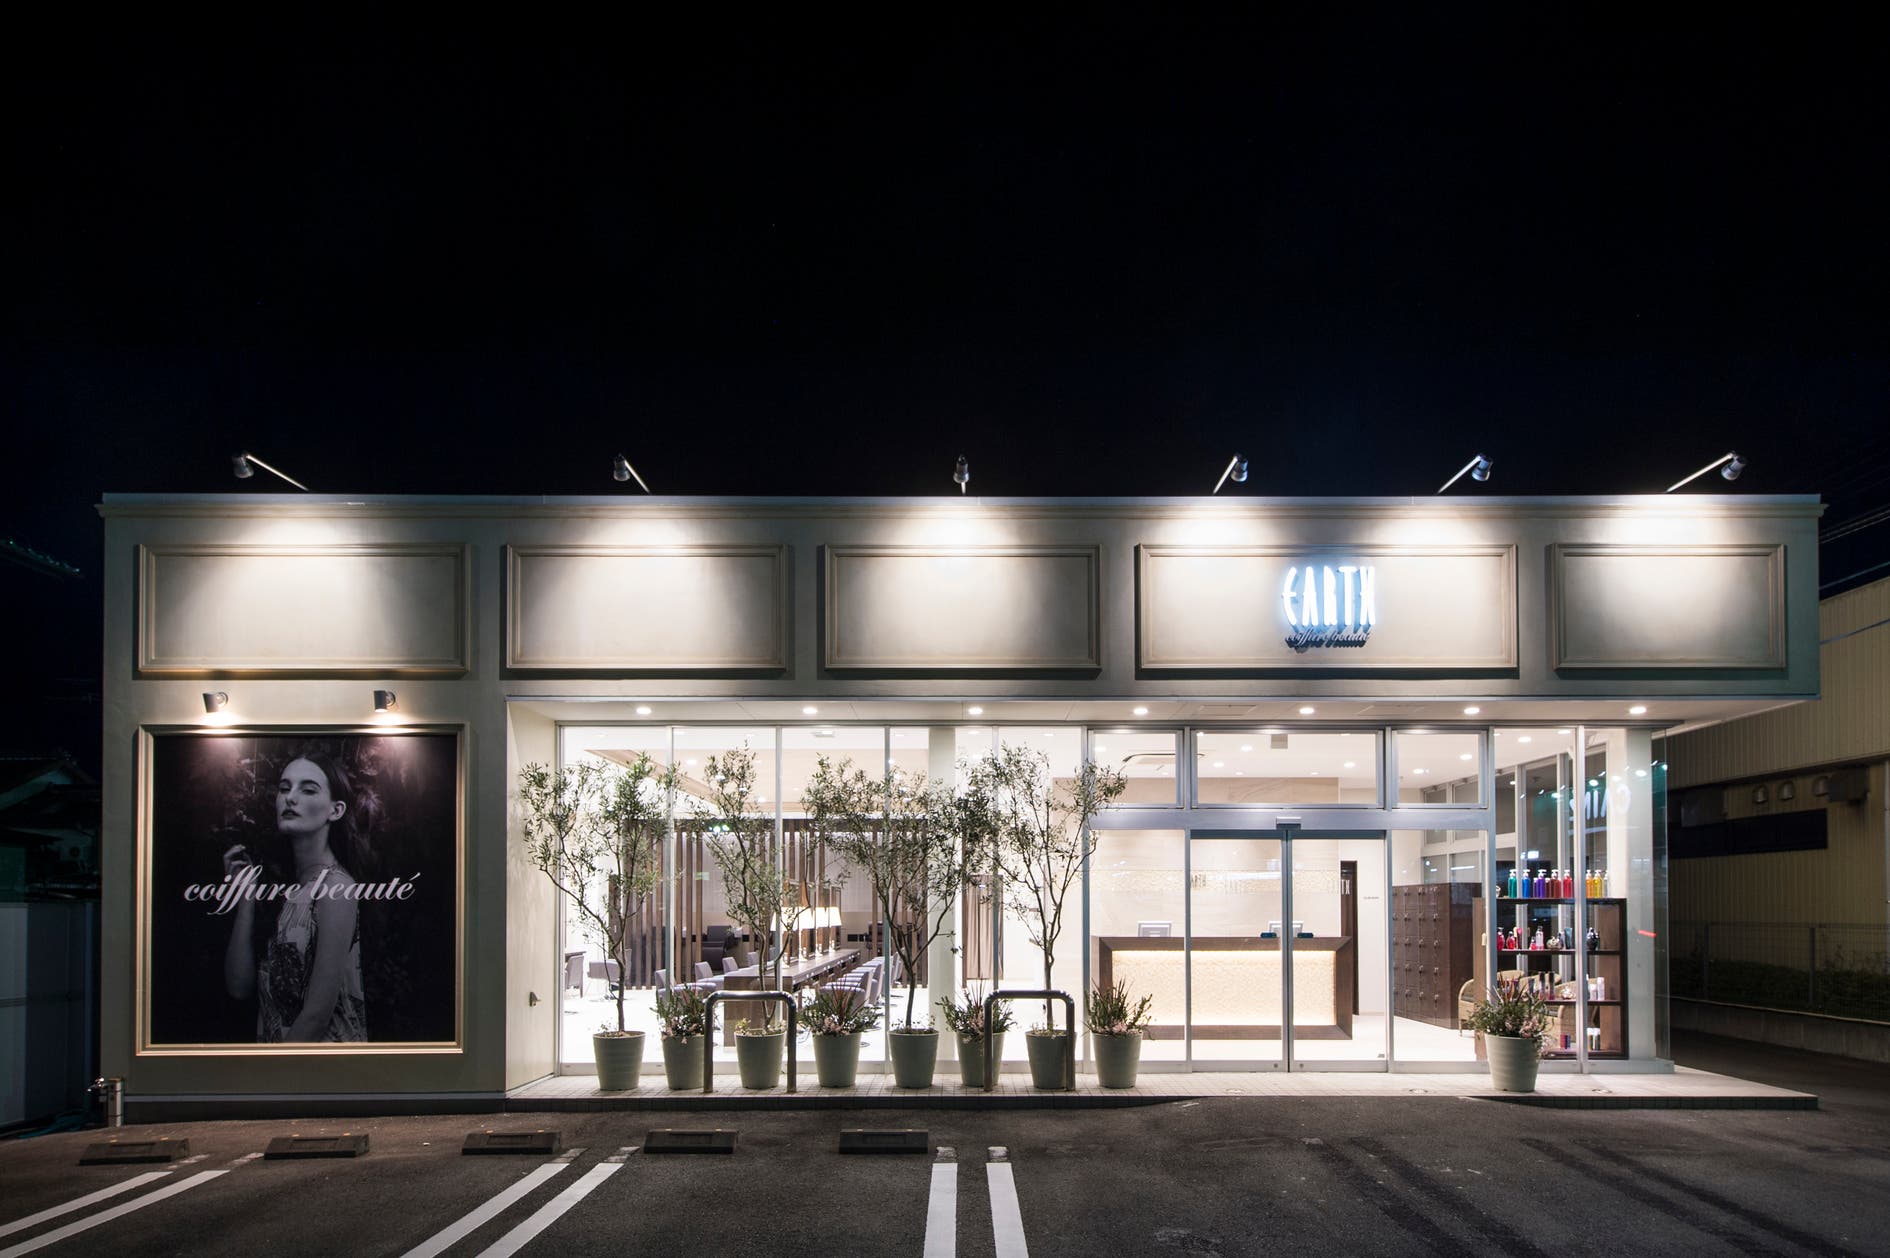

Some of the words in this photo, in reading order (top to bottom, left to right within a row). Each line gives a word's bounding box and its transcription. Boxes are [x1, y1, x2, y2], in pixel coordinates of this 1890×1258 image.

[1282, 566, 1376, 626] EARTH
[184, 864, 302, 915] coiffure
[310, 868, 421, 901] beauté
